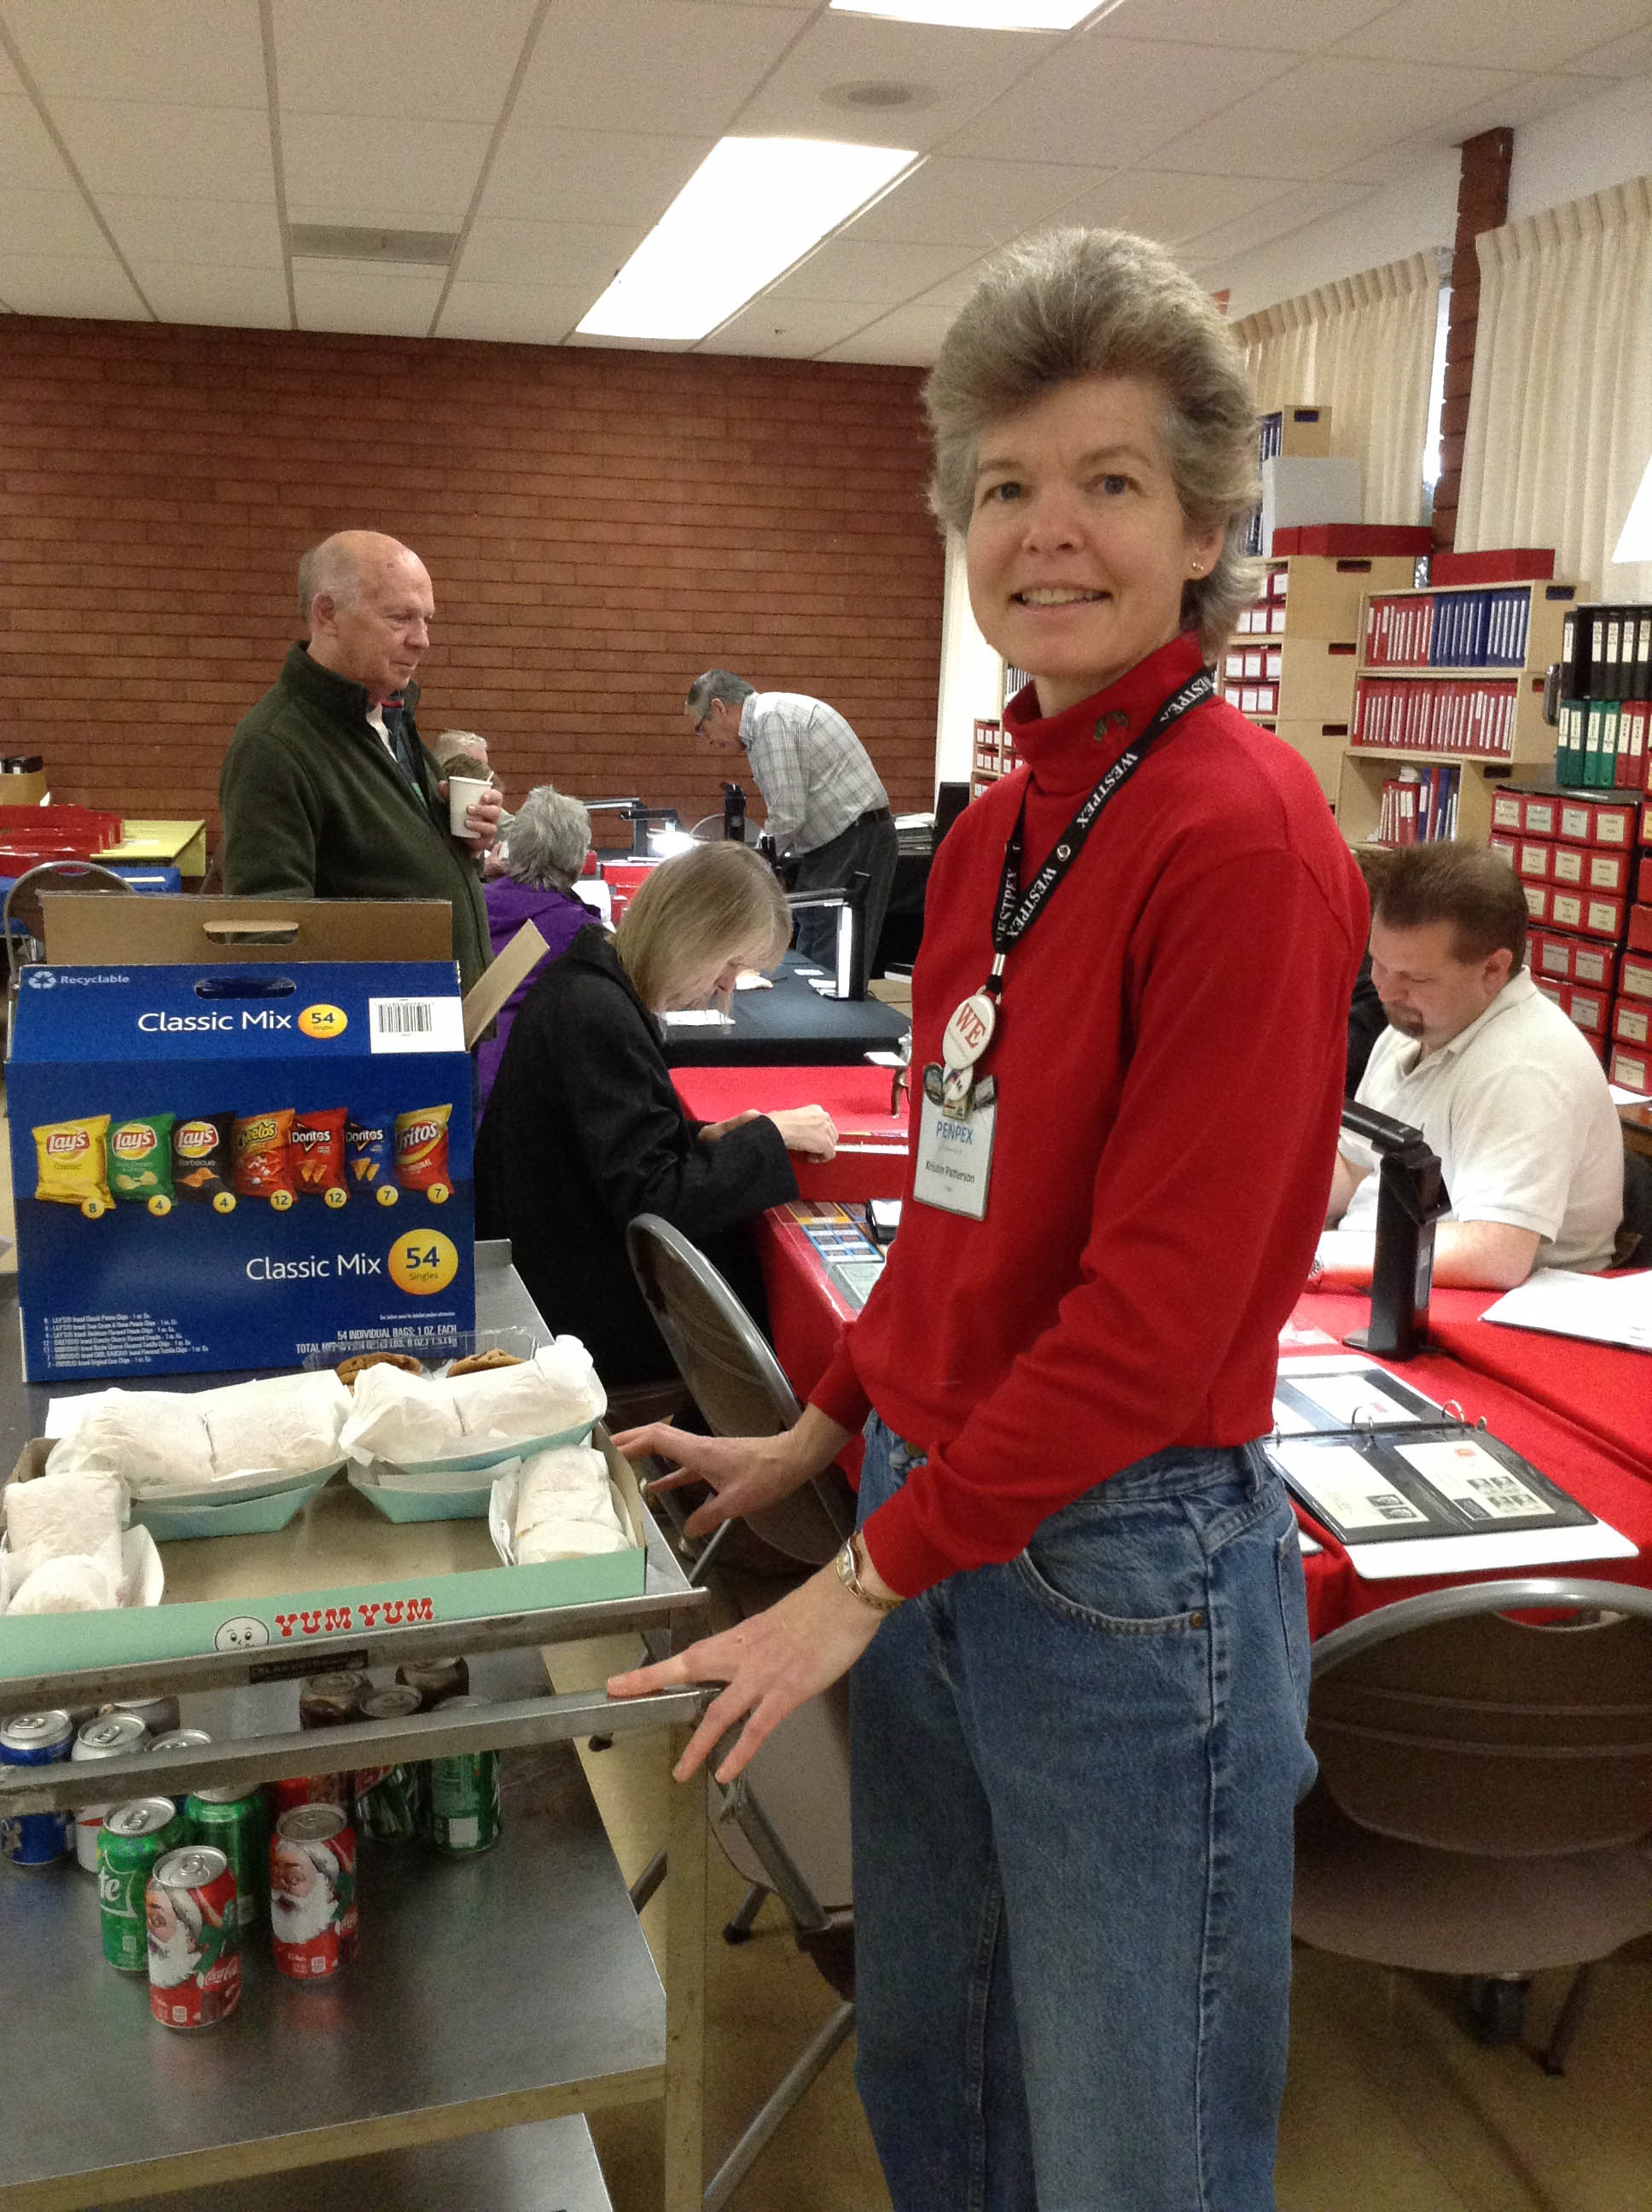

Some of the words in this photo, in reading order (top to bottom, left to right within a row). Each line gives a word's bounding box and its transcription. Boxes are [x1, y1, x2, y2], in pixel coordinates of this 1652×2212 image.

[1076, 752, 1138, 830] WESTPEX
[1006, 866, 1057, 939] WESTPEX
[61, 975, 130, 986] Recyclable
[137, 1011, 233, 1032] Classic
[241, 1010, 292, 1031] Mix
[311, 1012, 334, 1024] 54
[956, 1002, 986, 1049] WE
[237, 1120, 277, 1150] Cheetos
[292, 1131, 330, 1143] Doritos
[346, 1130, 383, 1143] Doritos
[936, 1121, 973, 1145] PENPEX
[925, 1159, 945, 1177] Kristin
[946, 1166, 975, 1185] Patterson
[329, 1192, 343, 1202] 12
[383, 1190, 392, 1201] 7
[434, 1188, 442, 1198] 7
[155, 1200, 164, 1209] 4
[220, 1197, 228, 1208] 4
[273, 1195, 288, 1205] 12
[88, 1203, 96, 1213] 8
[405, 1246, 440, 1269] 54
[246, 1254, 329, 1281] Classic
[337, 1253, 381, 1277] Mix
[409, 1272, 439, 1282] Singles
[337, 1330, 347, 1341] 54
[349, 1328, 391, 1340] INDIVIDUAL
[438, 1324, 457, 1335] EACH
[295, 1342, 321, 1354] TOTAL
[275, 1606, 352, 1638] YUM
[358, 1597, 433, 1627] YUM
